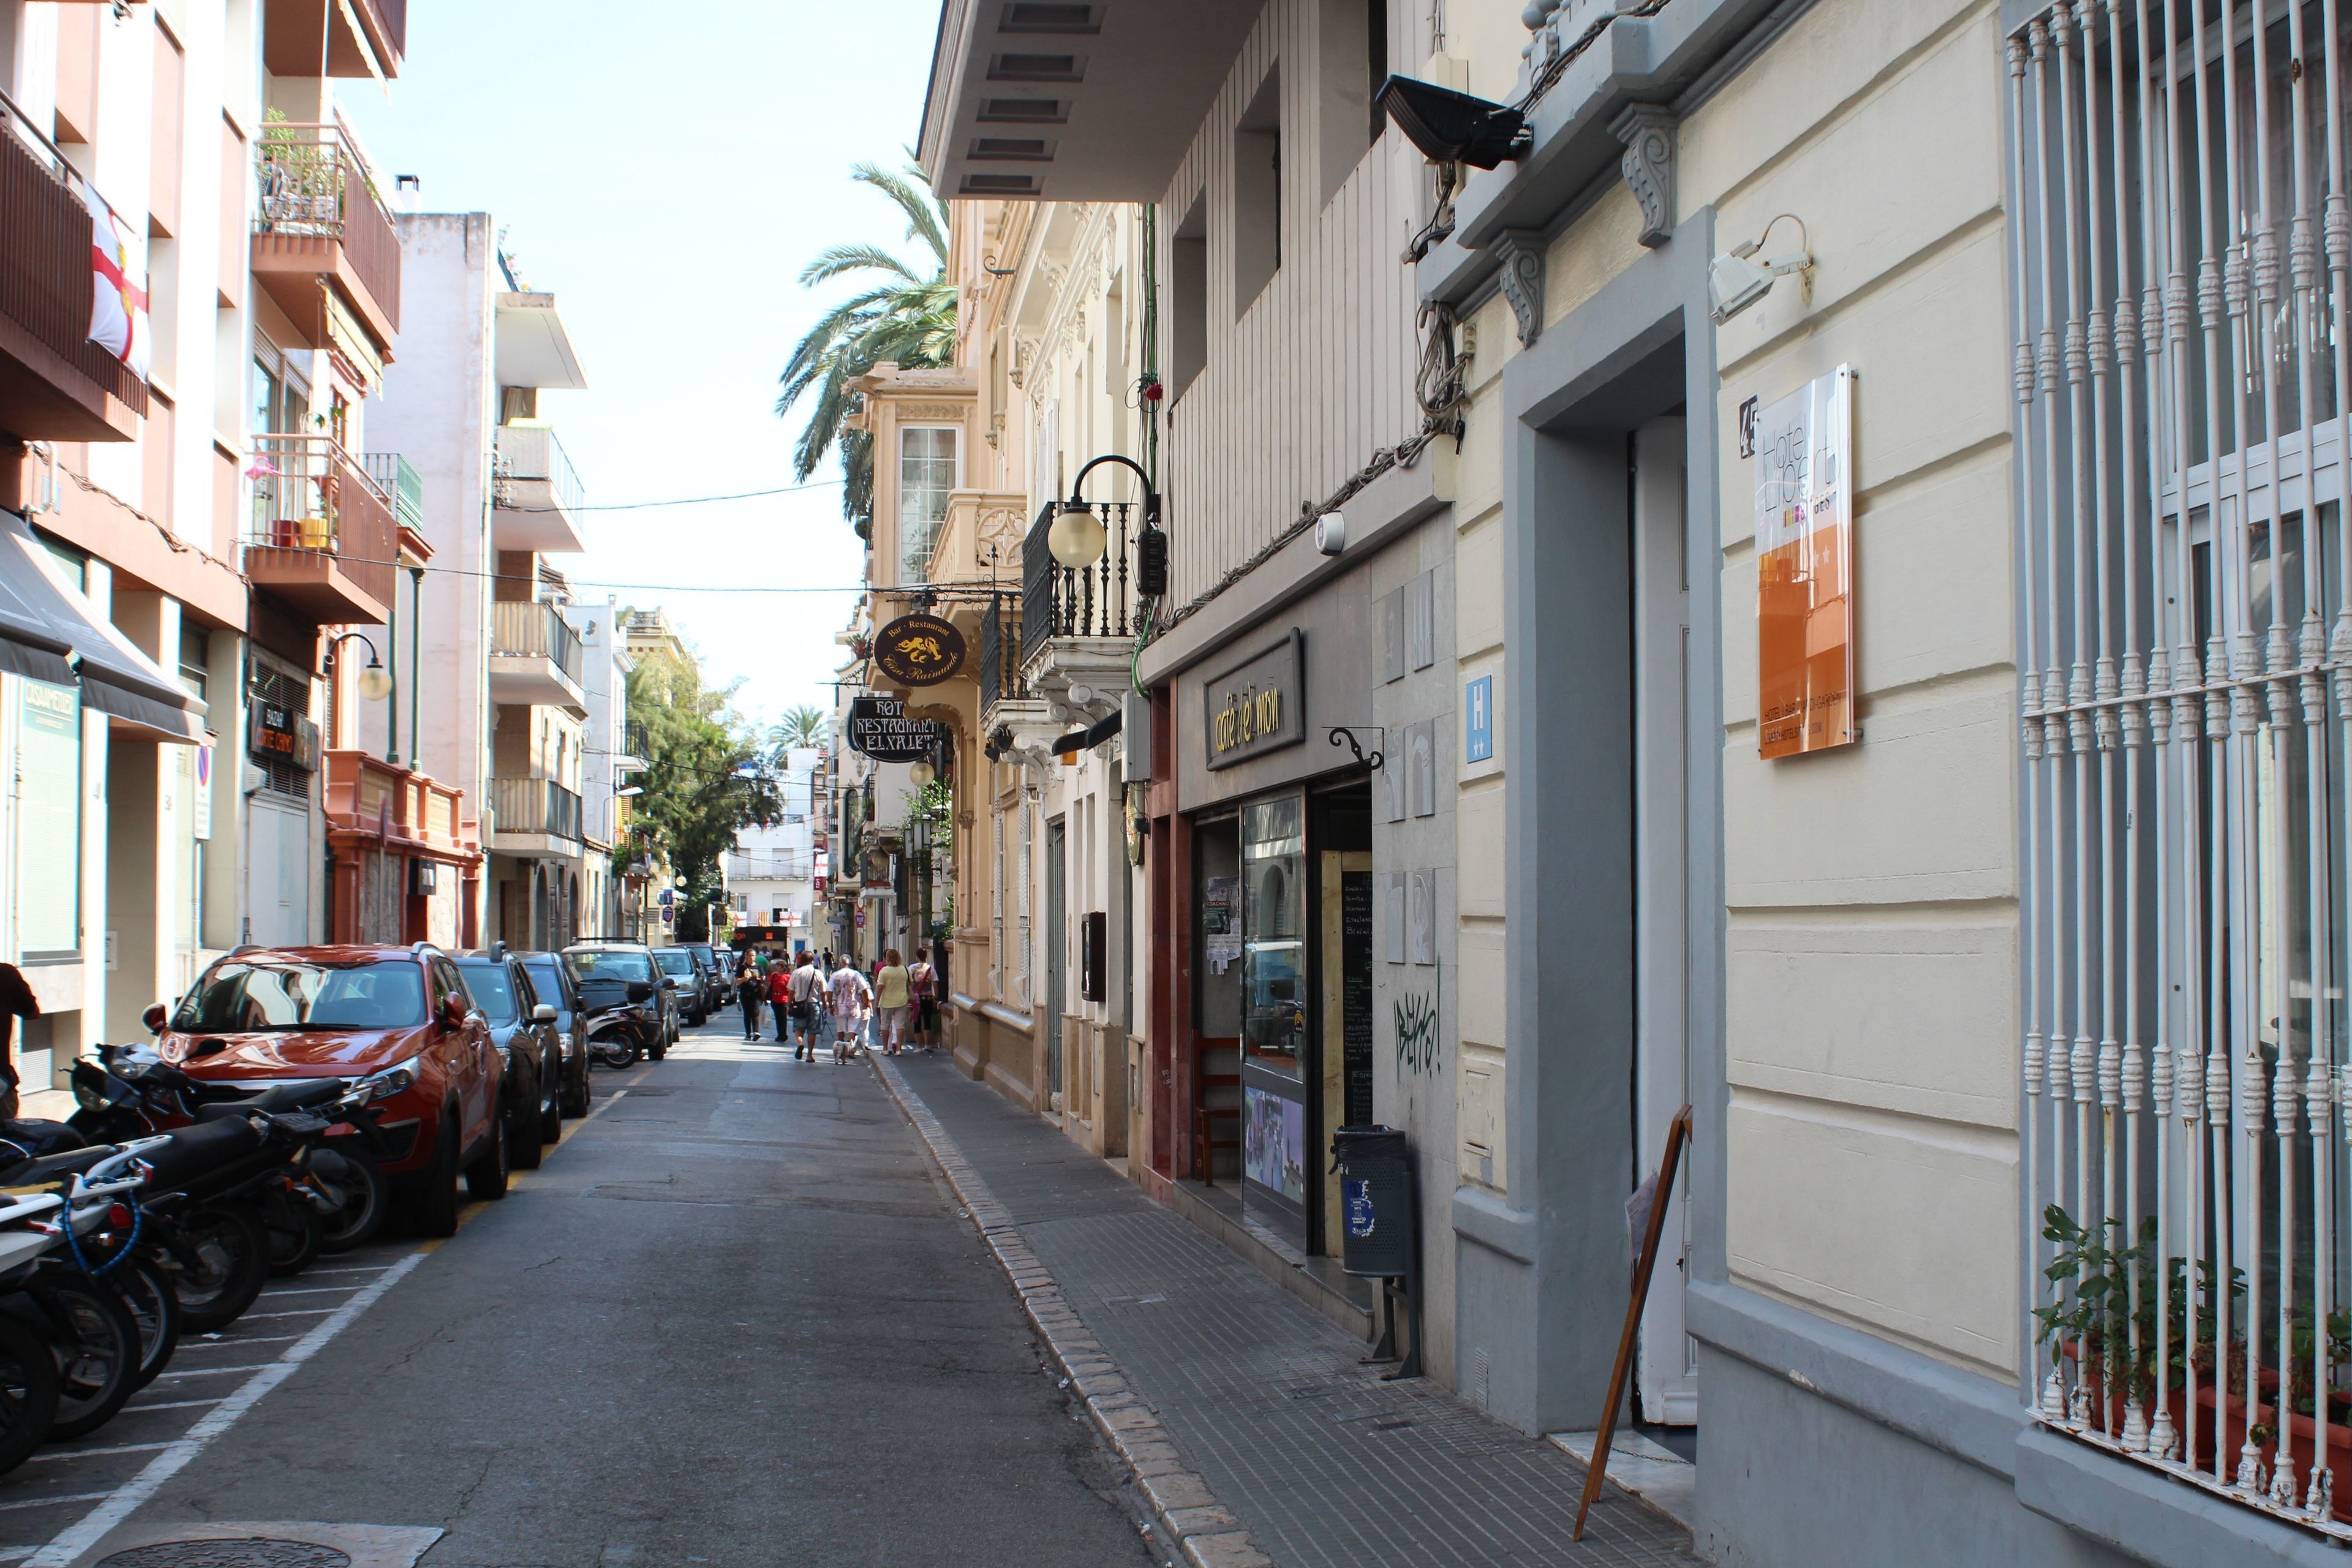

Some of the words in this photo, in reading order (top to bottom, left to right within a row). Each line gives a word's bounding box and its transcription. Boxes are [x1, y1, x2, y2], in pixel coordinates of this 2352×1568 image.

[1763, 413, 1806, 476] Hotel
[888, 626, 902, 638] Bar
[908, 620, 950, 637] Restaurant
[883, 654, 904, 676] Casa
[906, 652, 959, 680] Raimundo
[875, 700, 903, 716] HOT
[1473, 684, 1483, 731] H
[855, 718, 937, 734] RESTAURANT
